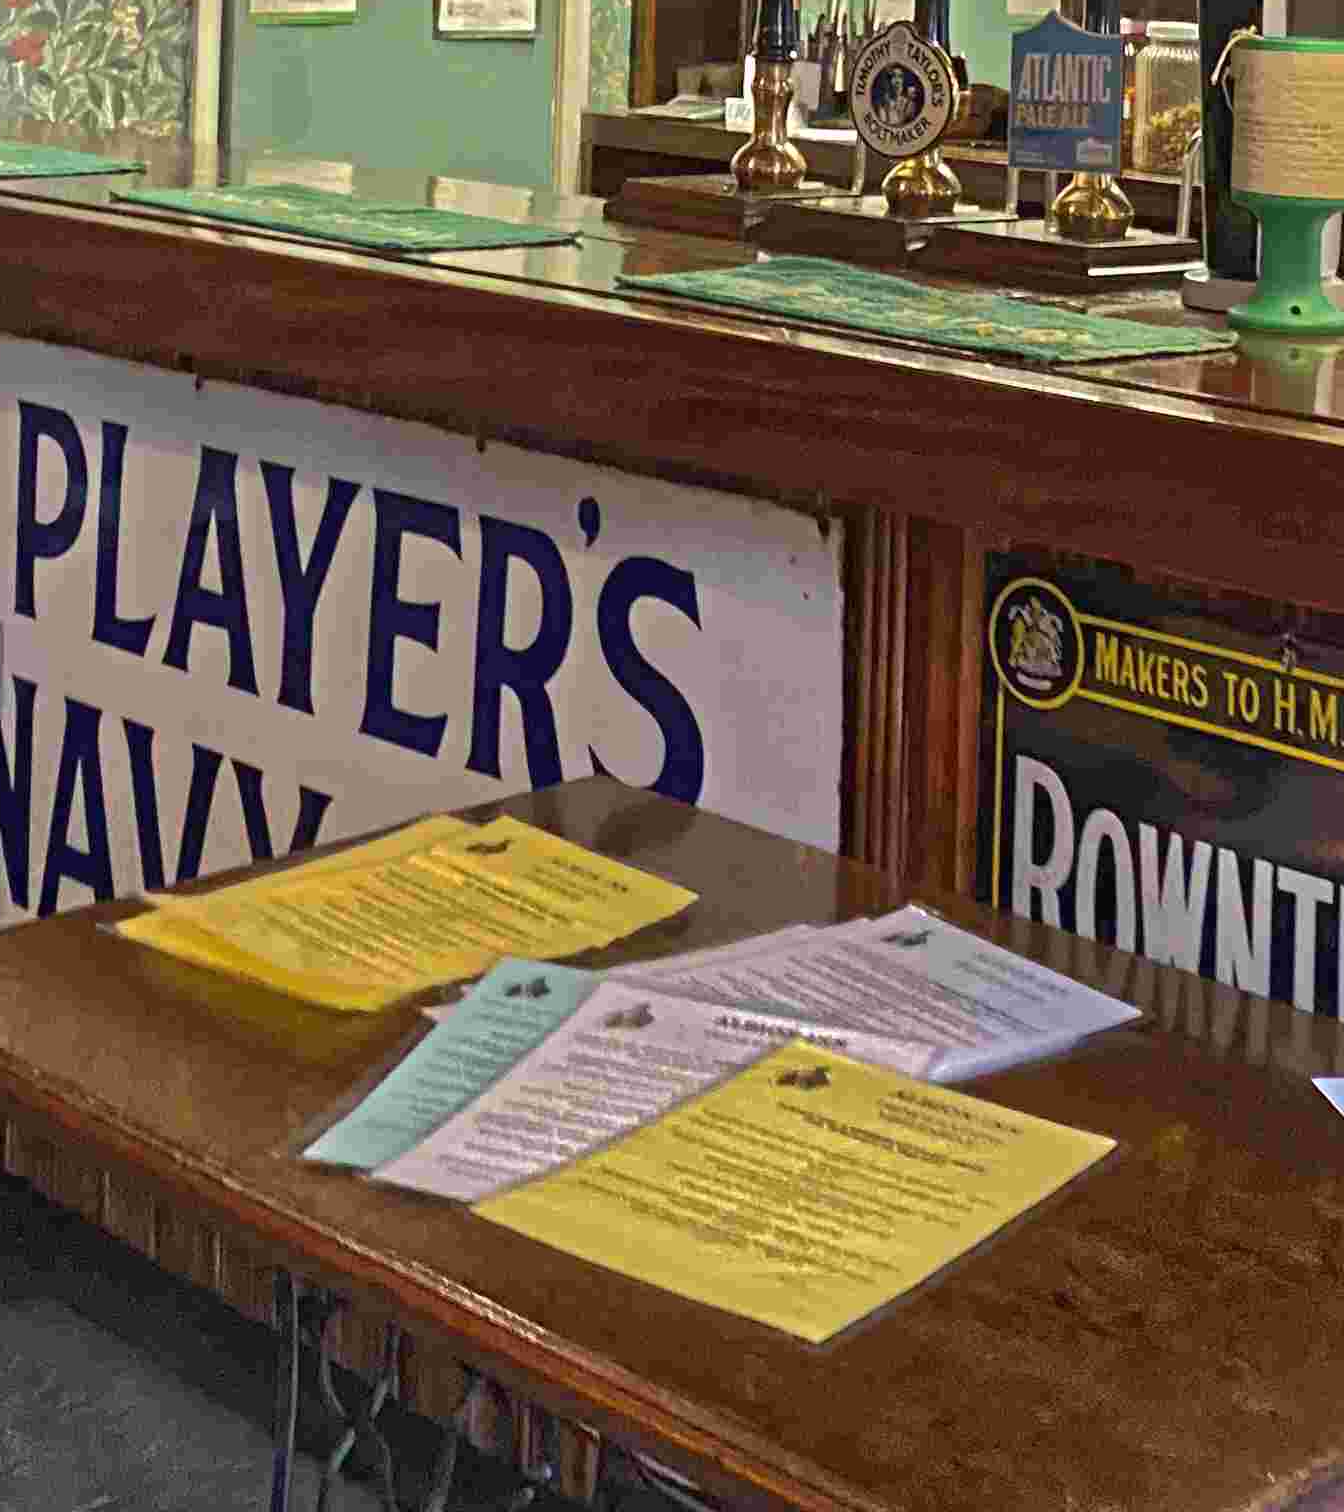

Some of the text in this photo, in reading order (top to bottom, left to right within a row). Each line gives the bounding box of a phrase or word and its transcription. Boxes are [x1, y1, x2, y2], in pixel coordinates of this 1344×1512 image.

[1016, 53, 1113, 103] ATLANTIC
[14, 398, 706, 808] PLAYER'S
[1094, 634, 1209, 709] MAKERS
[1221, 672, 1261, 723] TO
